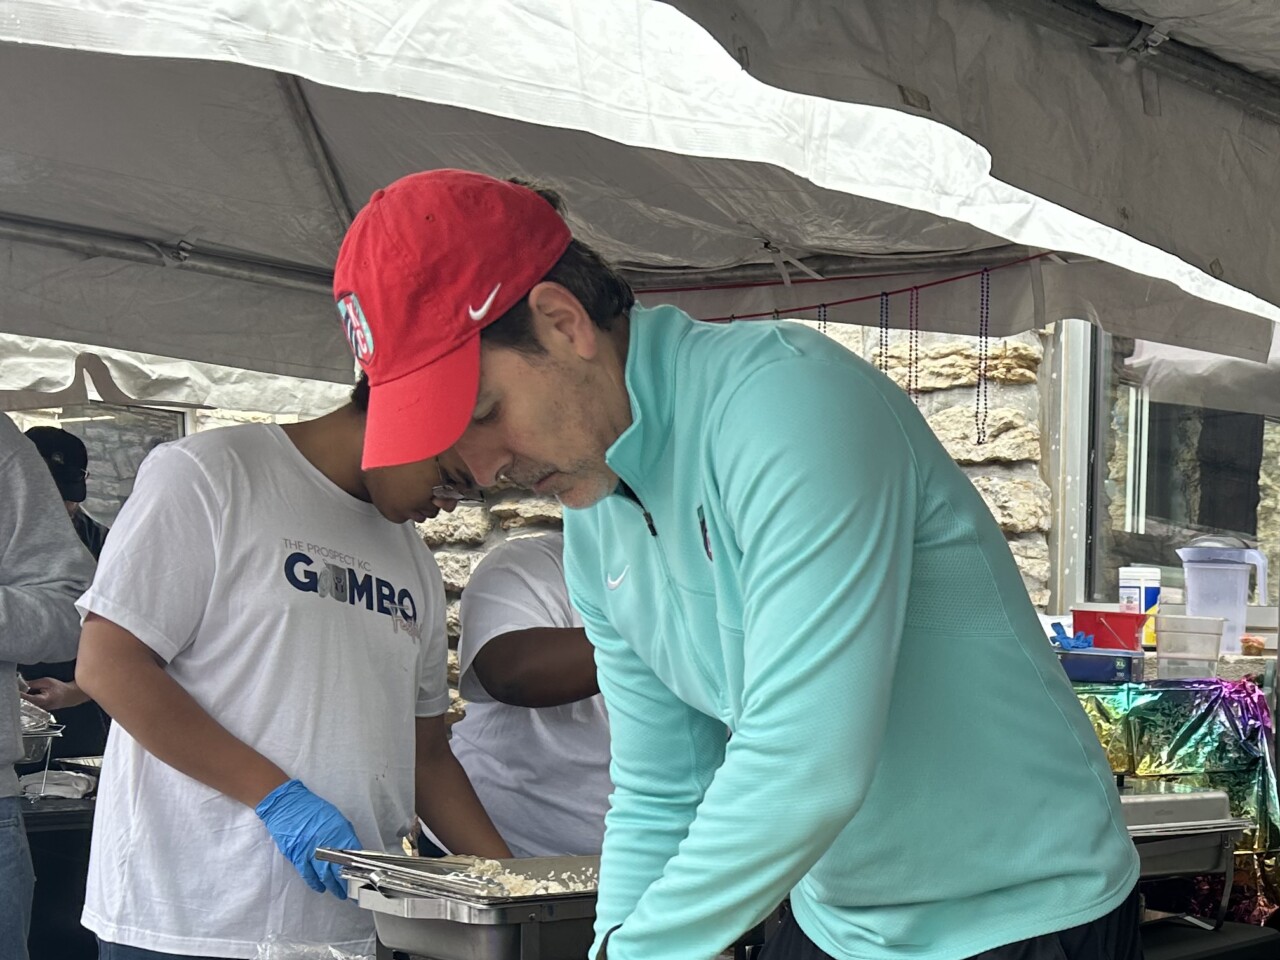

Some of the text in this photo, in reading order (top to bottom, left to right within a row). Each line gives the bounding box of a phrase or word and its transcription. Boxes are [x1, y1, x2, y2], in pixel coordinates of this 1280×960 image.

[283, 538, 372, 572] THE PROSPECT KC
